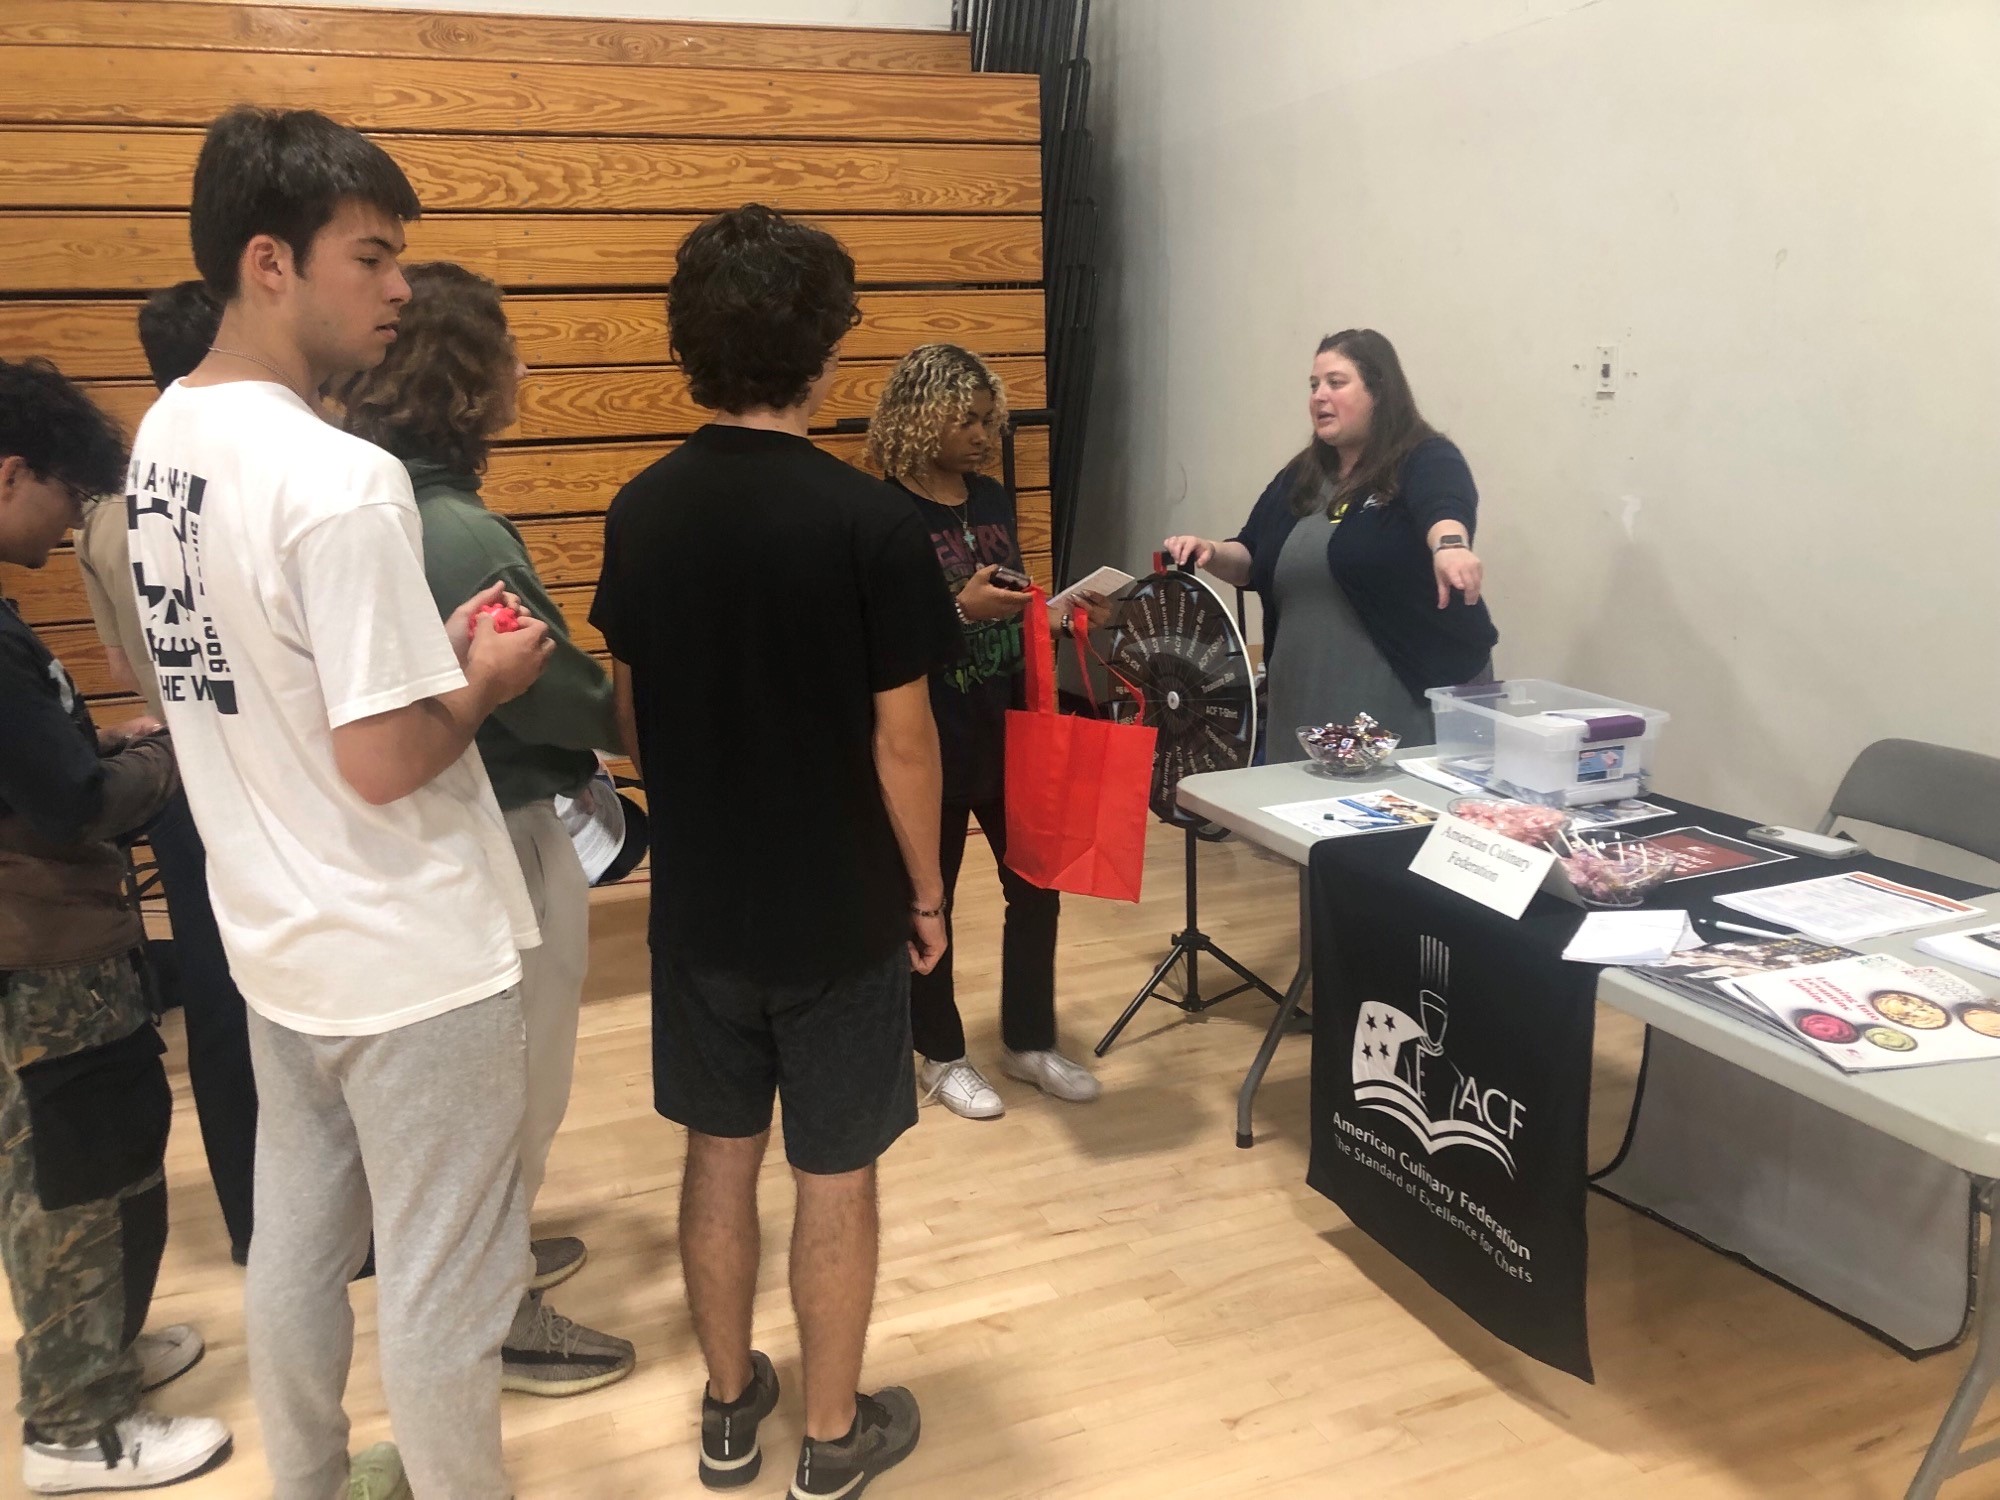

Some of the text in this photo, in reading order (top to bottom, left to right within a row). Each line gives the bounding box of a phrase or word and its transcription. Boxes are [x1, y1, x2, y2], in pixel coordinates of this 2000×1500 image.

[1441, 826, 1533, 873] American Culinary
[1447, 851, 1499, 882] Federation
[1459, 1076, 1527, 1140] ACF
[1333, 1111, 1532, 1262] American Culinary Federation
[1354, 1147, 1404, 1188] Standard
[1406, 1183, 1417, 1197] of
[1419, 1188, 1478, 1241] Excellence
[1479, 1232, 1494, 1256] for
[1494, 1249, 1534, 1284] Chefs
